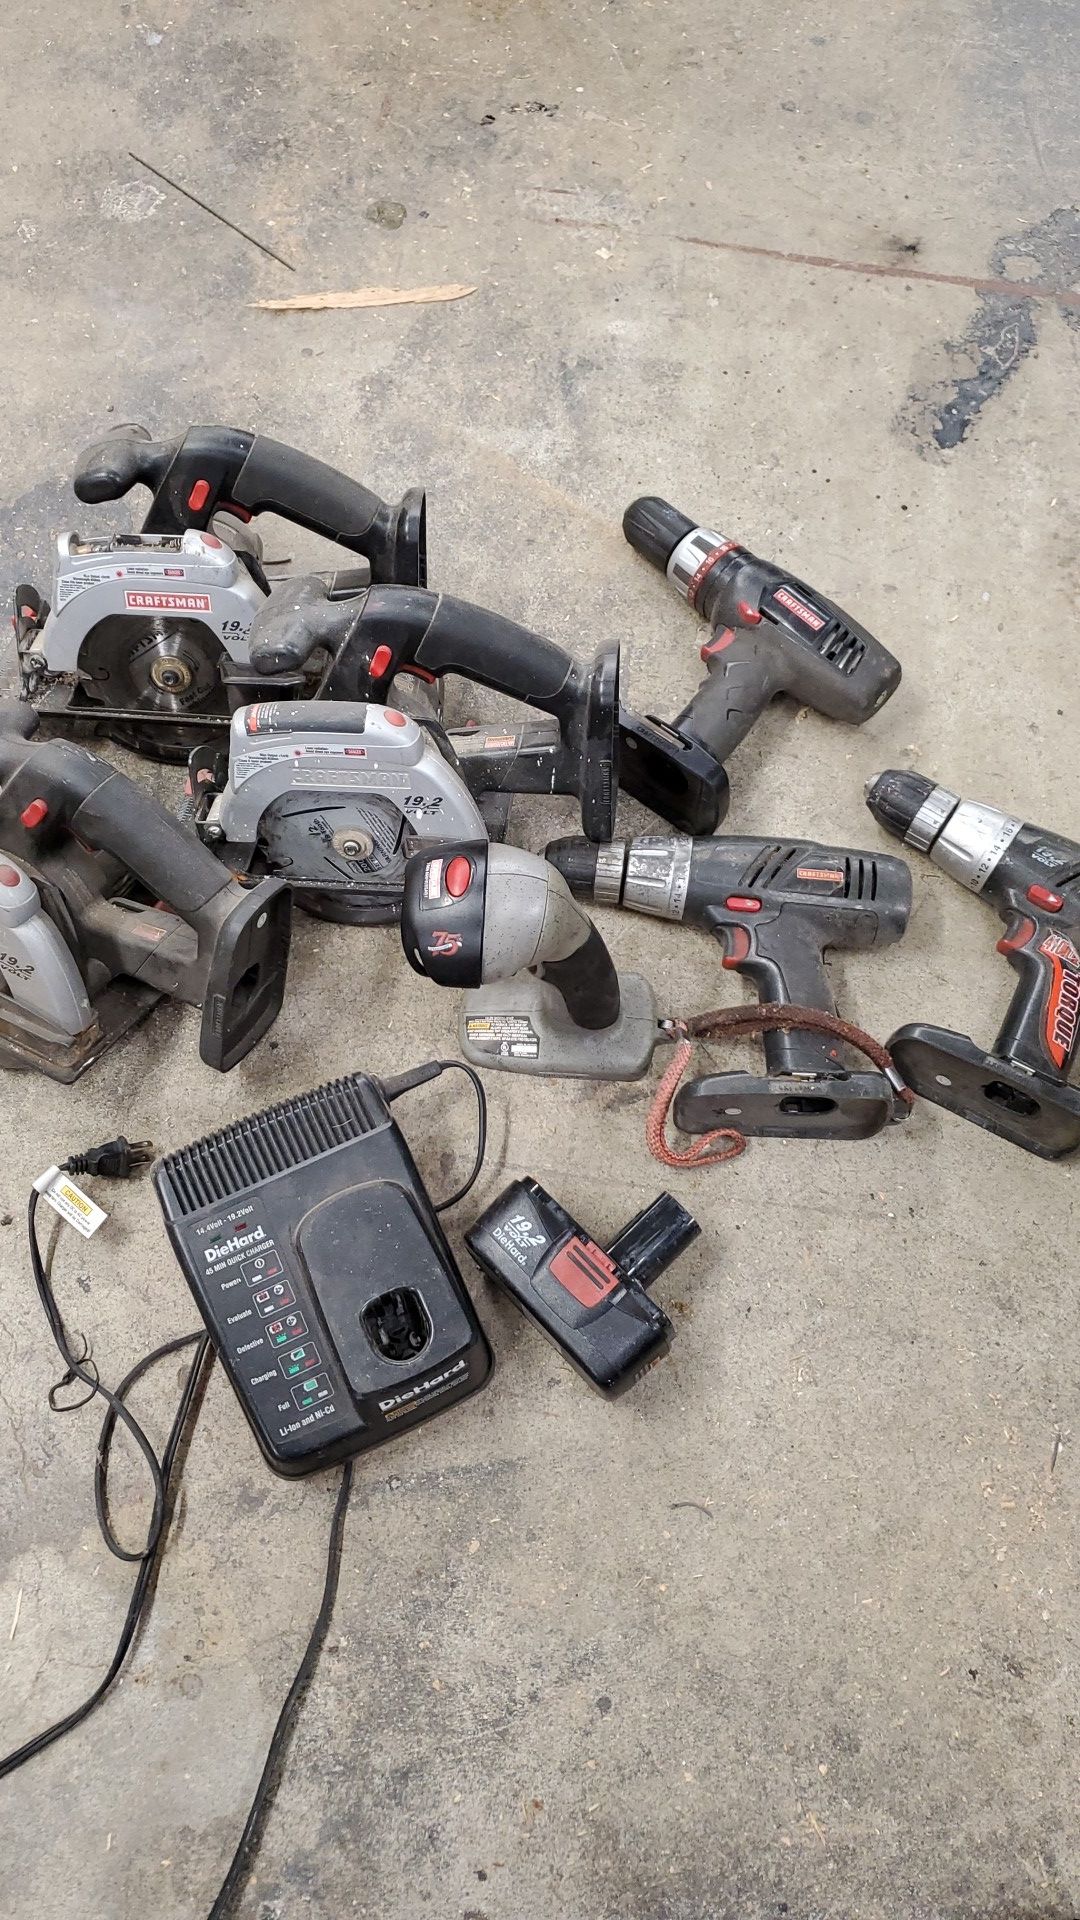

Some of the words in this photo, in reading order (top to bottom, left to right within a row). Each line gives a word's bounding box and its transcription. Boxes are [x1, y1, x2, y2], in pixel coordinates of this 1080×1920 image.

[128, 595, 207, 609] CRAFTSMAN
[777, 592, 820, 626] CRAFTSMAN
[404, 796, 443, 808] 19.2
[979, 863, 989, 873] 12
[0, 953, 35, 974] 19.2
[1051, 968, 1080, 1052] TORQUE
[64, 1189, 89, 1212] CAUTION
[196, 1220, 223, 1235] 14.4Volt
[227, 1205, 254, 1222] 19.2Volt
[510, 1215, 546, 1246] 19.2
[504, 1225, 528, 1248] VOLT
[214, 1262, 227, 1272] MIN
[227, 1252, 247, 1266] QUICK
[246, 1239, 275, 1257] CHARGER
[227, 1309, 252, 1325] Evaluate
[236, 1338, 264, 1355] Defective
[250, 1369, 277, 1386] Charging
[302, 1413, 316, 1426] and
[314, 1404, 336, 1419] Ni-Cd
